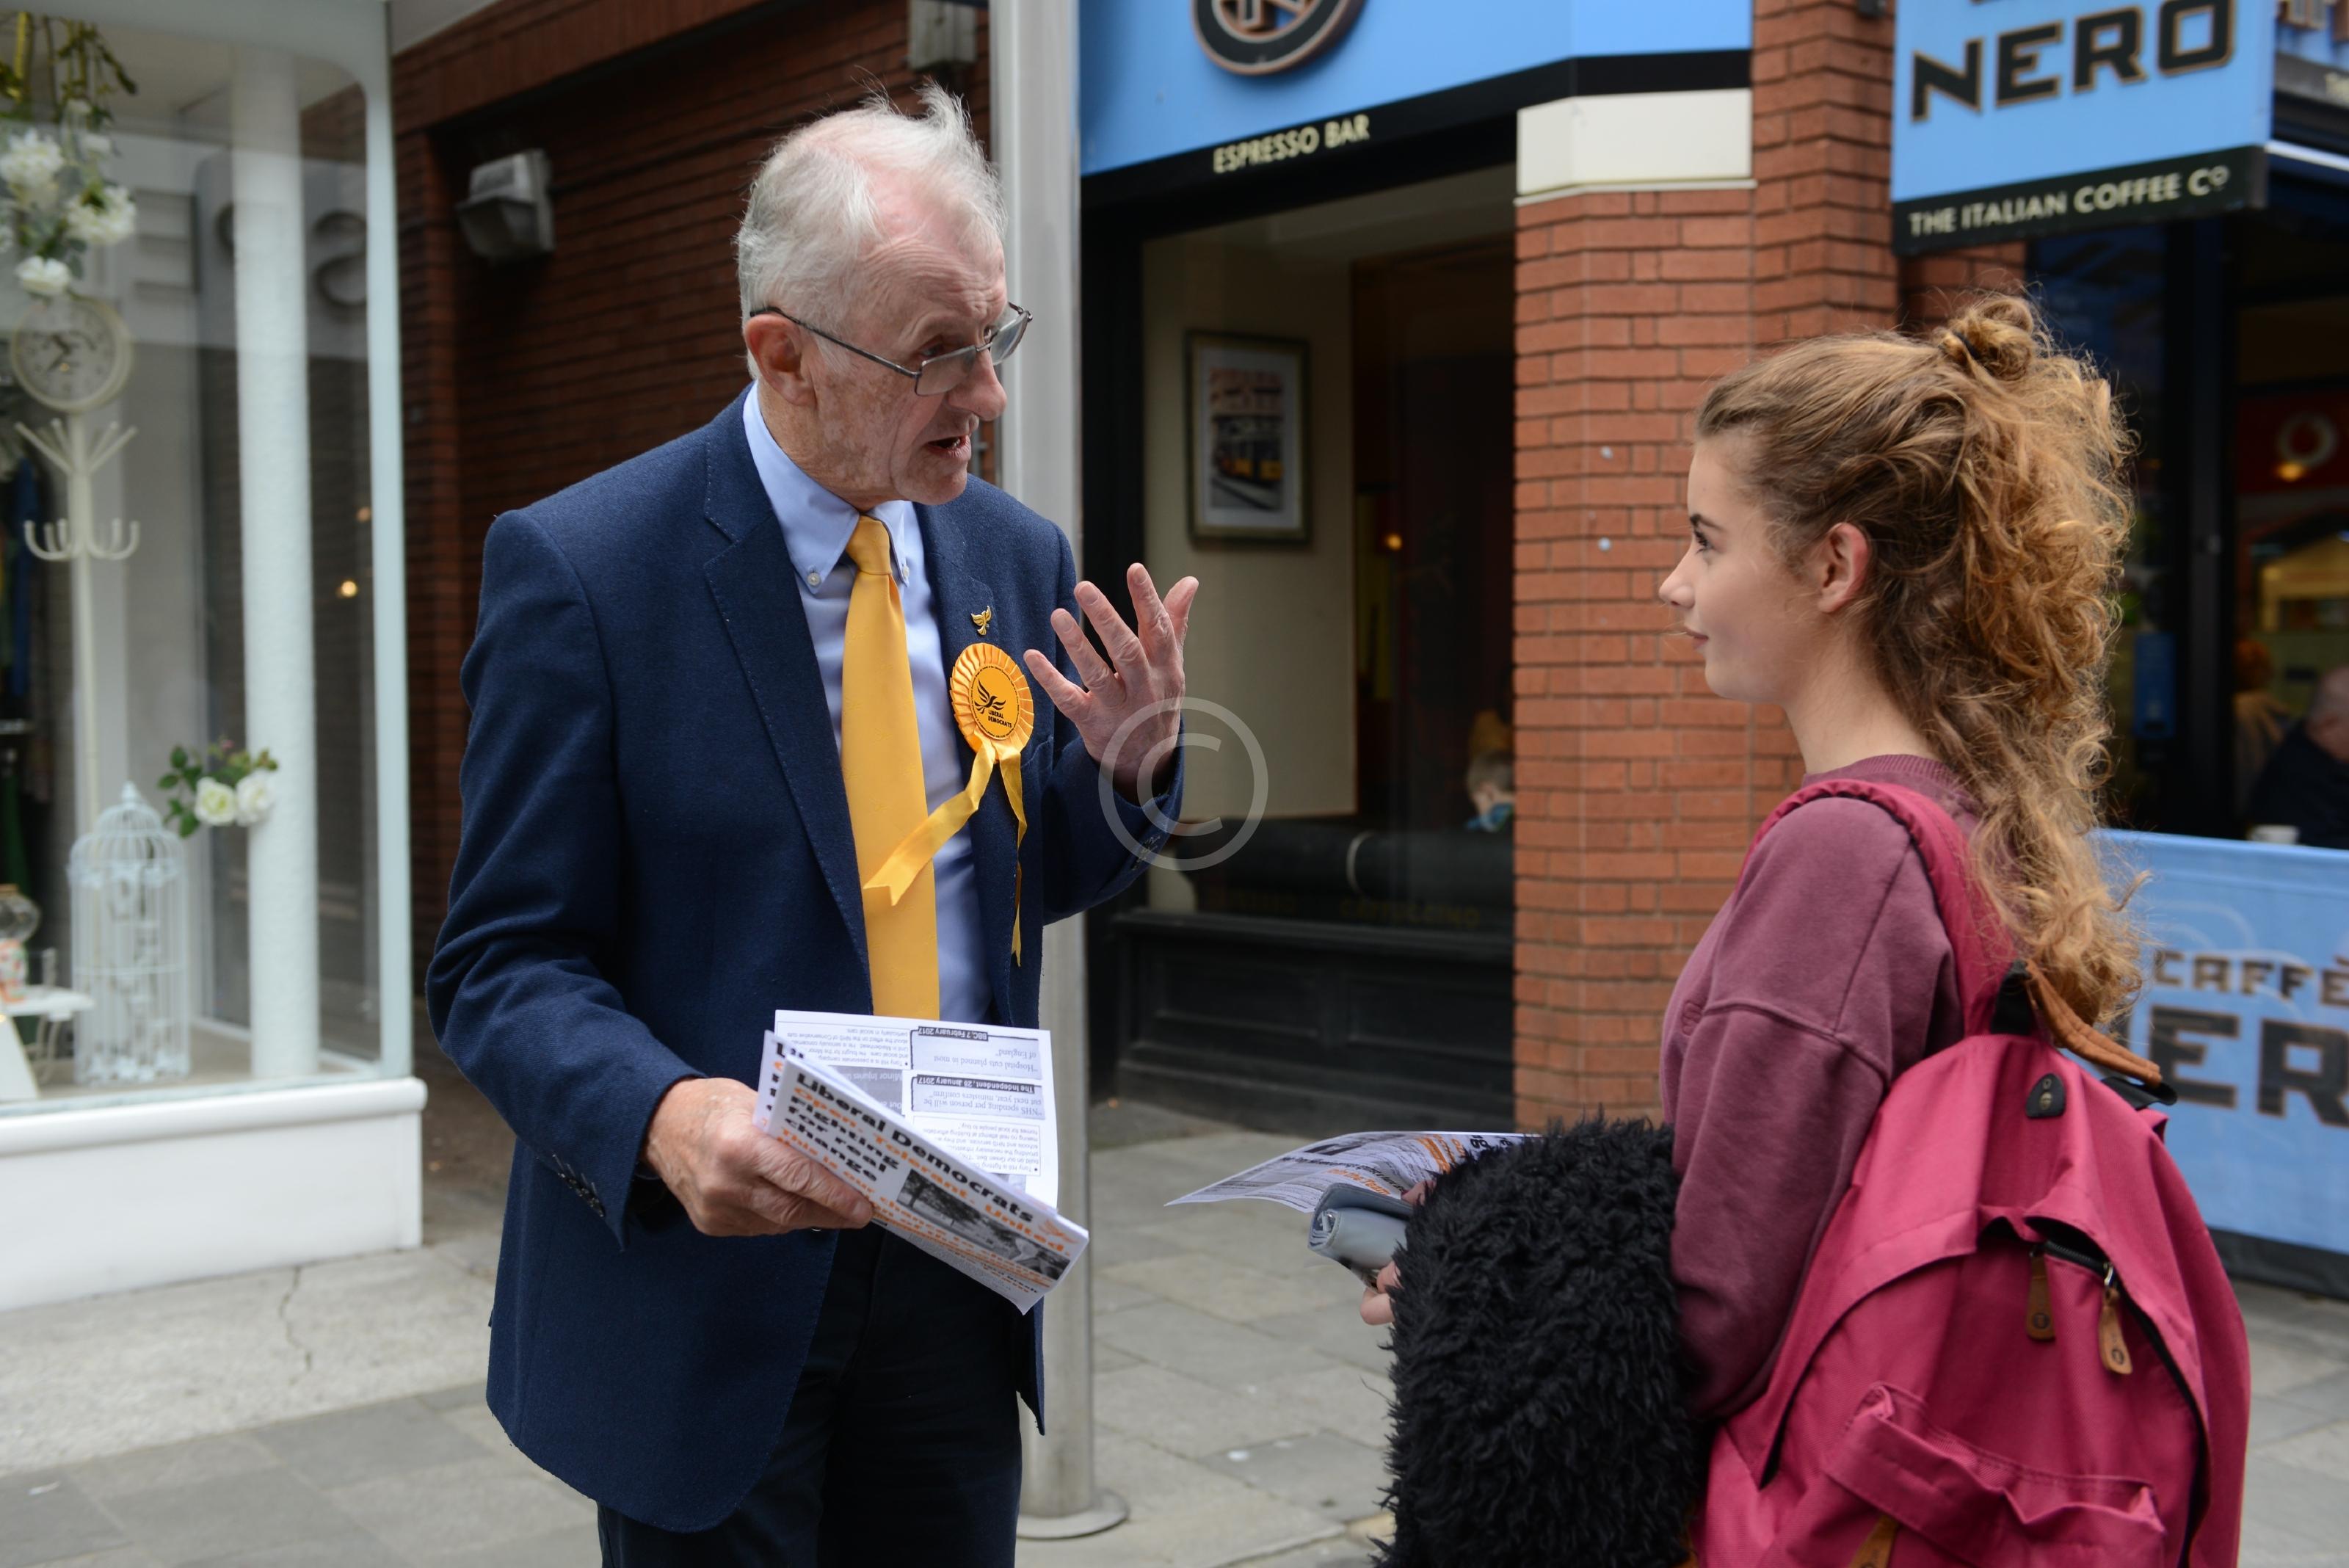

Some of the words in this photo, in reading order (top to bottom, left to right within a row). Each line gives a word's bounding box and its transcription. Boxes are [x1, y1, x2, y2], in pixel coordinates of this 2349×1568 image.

[1912, 0, 2234, 120] NERO
[1213, 125, 1320, 173] ESPRESSO
[1324, 115, 1370, 148] BAR
[1910, 206, 1956, 236] THE
[1961, 191, 2066, 228] ITALIAN
[2074, 171, 2182, 213] COFFEE
[988, 708, 1004, 719] LIBERAL
[987, 716, 1012, 728] DEMOCRATS
[918, 1026, 934, 1035] 2017
[934, 1028, 965, 1037] February
[966, 1030, 970, 1038] 7
[852, 1070, 877, 1081] Injuries
[879, 1072, 902, 1081] Minor
[918, 1075, 934, 1084] 2017
[935, 1077, 962, 1086] January
[1020, 1084, 1033, 1092] The
[923, 1097, 932, 1106] be
[974, 1101, 986, 1109] per
[988, 1102, 1019, 1112] spending
[789, 1095, 899, 1169] Fighting
[788, 1106, 827, 1132] for
[835, 1137, 887, 1172] real
[785, 1118, 877, 1182] change
[797, 1072, 886, 1132] Liberal
[891, 1130, 1033, 1222] Democrats
